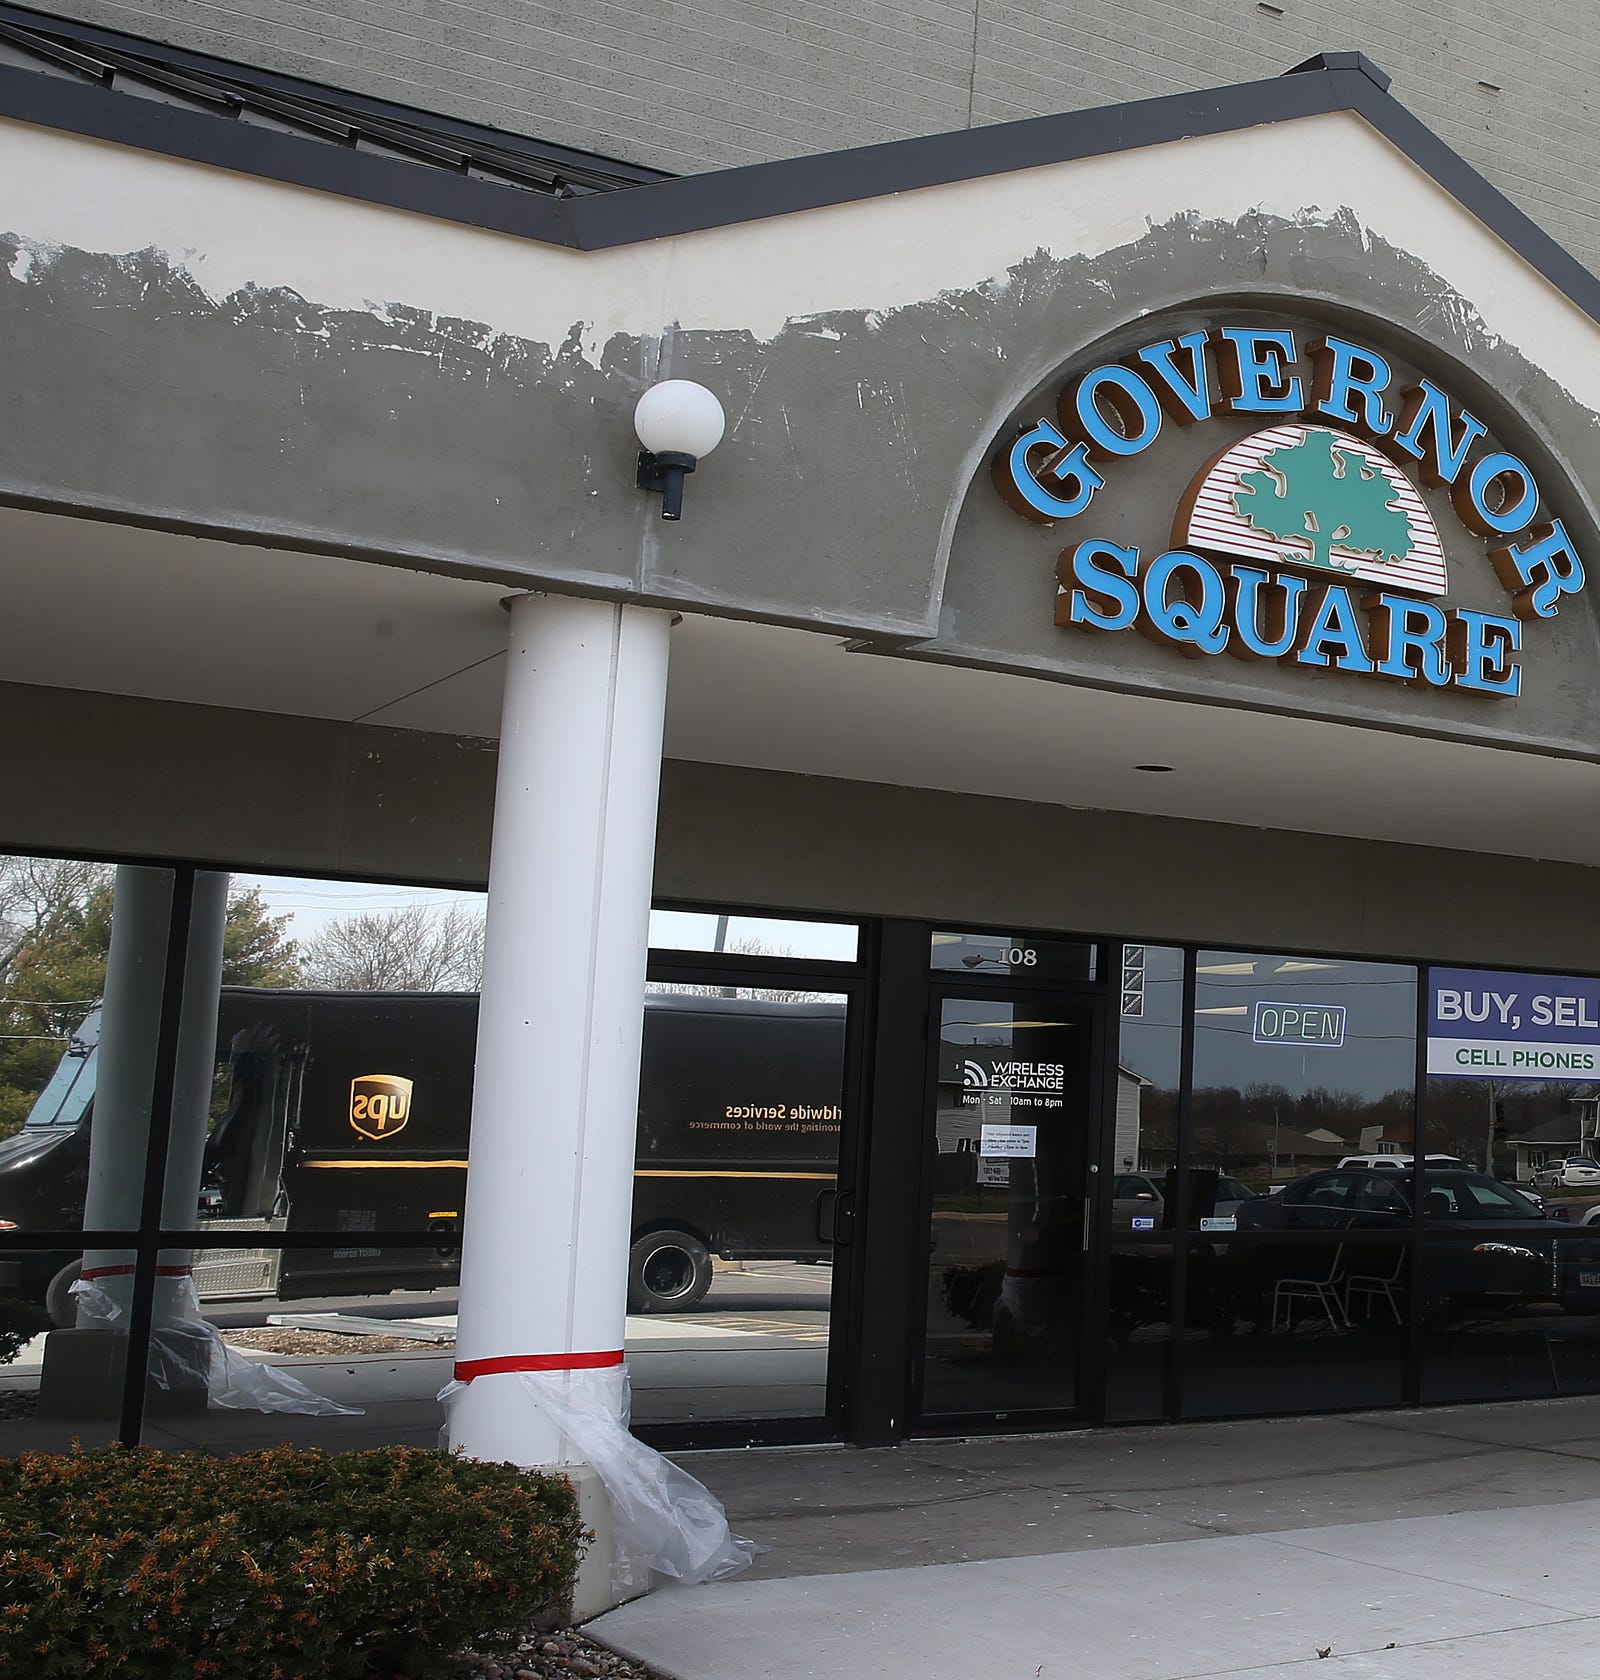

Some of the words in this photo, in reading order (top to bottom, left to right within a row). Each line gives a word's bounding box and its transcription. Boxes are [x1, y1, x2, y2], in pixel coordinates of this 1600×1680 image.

[1006, 326, 1587, 619] GOVERNOR
[1064, 537, 1522, 698] SQUARE
[998, 948, 1038, 966] 108
[1437, 989, 1521, 1031] BUY,
[1261, 1009, 1340, 1040] OPEN
[991, 1060, 1064, 1076] WIRELESS
[1455, 1048, 1507, 1067] CELL
[1513, 1051, 1595, 1070] PHONES
[990, 1075, 1064, 1090] EXCHANGE
[962, 1095, 981, 1104] Mon
[989, 1096, 1002, 1105] Sat
[1010, 1096, 1032, 1107] 10am
[1034, 1097, 1043, 1107] to
[1044, 1098, 1063, 1109] 8pm
